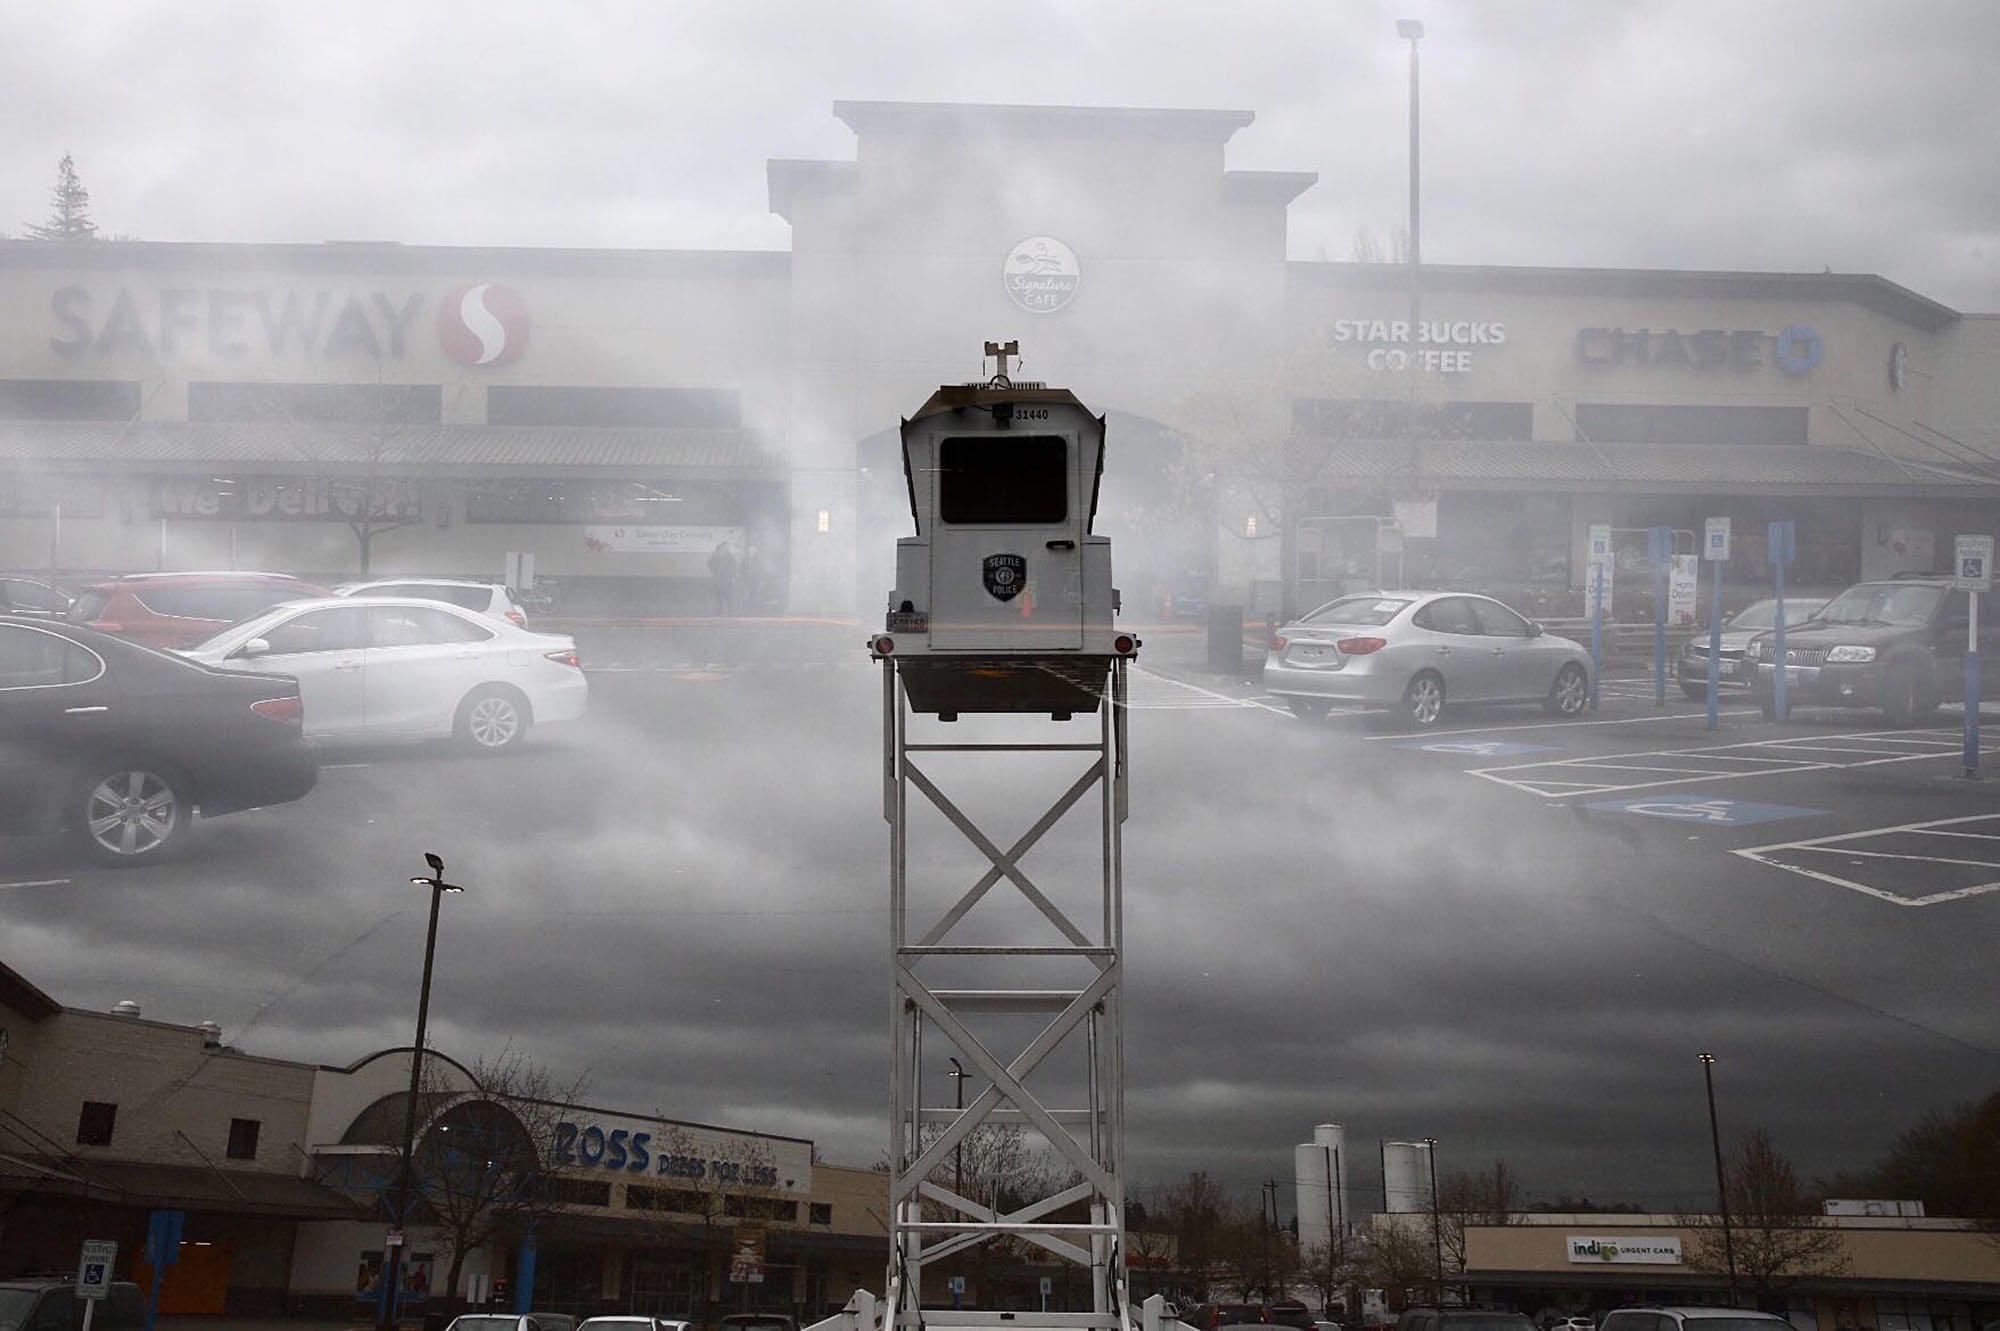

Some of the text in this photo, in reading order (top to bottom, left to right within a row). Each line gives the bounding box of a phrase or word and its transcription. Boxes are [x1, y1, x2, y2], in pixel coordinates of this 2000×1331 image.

[1012, 276, 1072, 295] Signature
[1024, 294, 1057, 307] CAFE
[50, 285, 429, 361] SAFEWAY
[1576, 327, 1763, 370] CHASE
[1015, 408, 1049, 421] 31440
[989, 557, 1021, 568] SEATTLE
[993, 584, 1018, 594] POLICE
[556, 1121, 651, 1173] ROSS
[1620, 1246, 1651, 1255] URGENT
